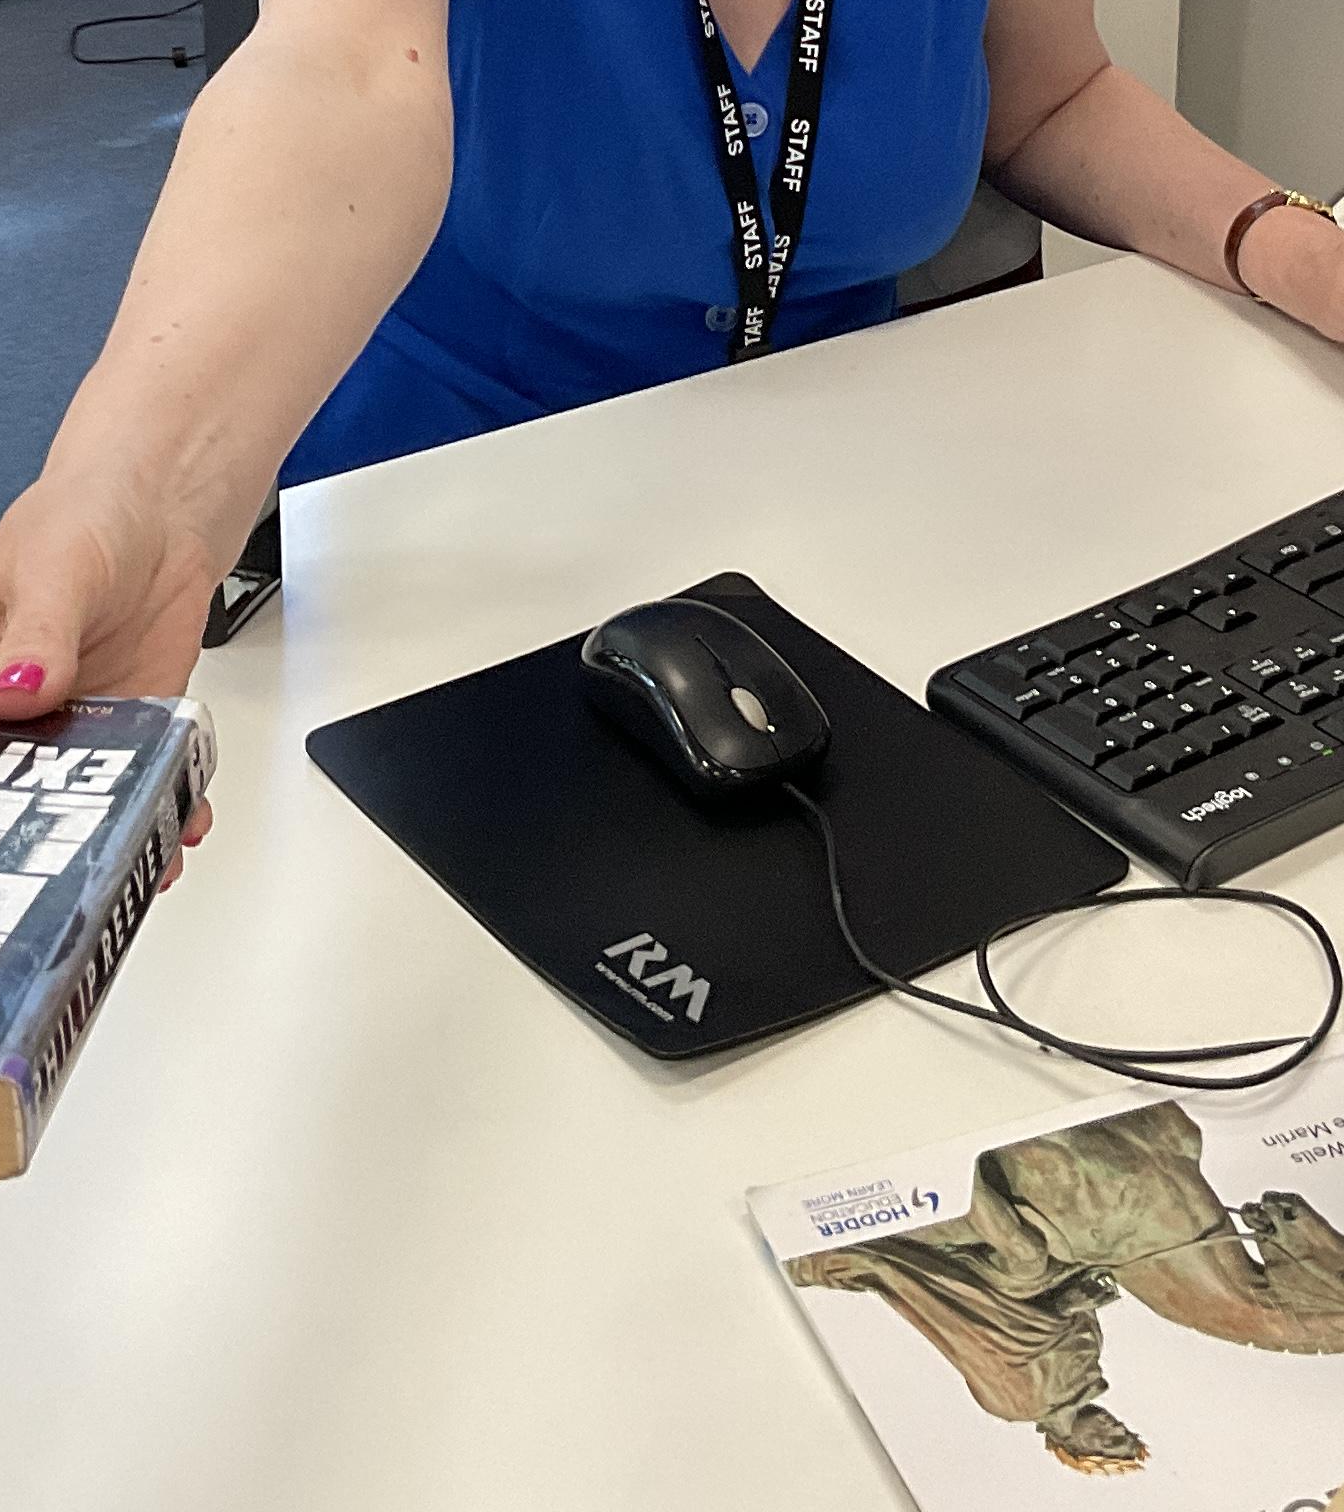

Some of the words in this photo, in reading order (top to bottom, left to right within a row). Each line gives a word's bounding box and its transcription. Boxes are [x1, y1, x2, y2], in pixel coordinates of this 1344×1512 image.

[717, 84, 743, 156] STAFF
[782, 119, 810, 192] STAFF
[737, 201, 763, 269] STAFF
[744, 306, 764, 347] TAFF
[1181, 786, 1254, 824] logitech
[99, 838, 159, 976] REEVE
[1261, 1121, 1333, 1147] Martin
[817, 1204, 910, 1237] HODDER
